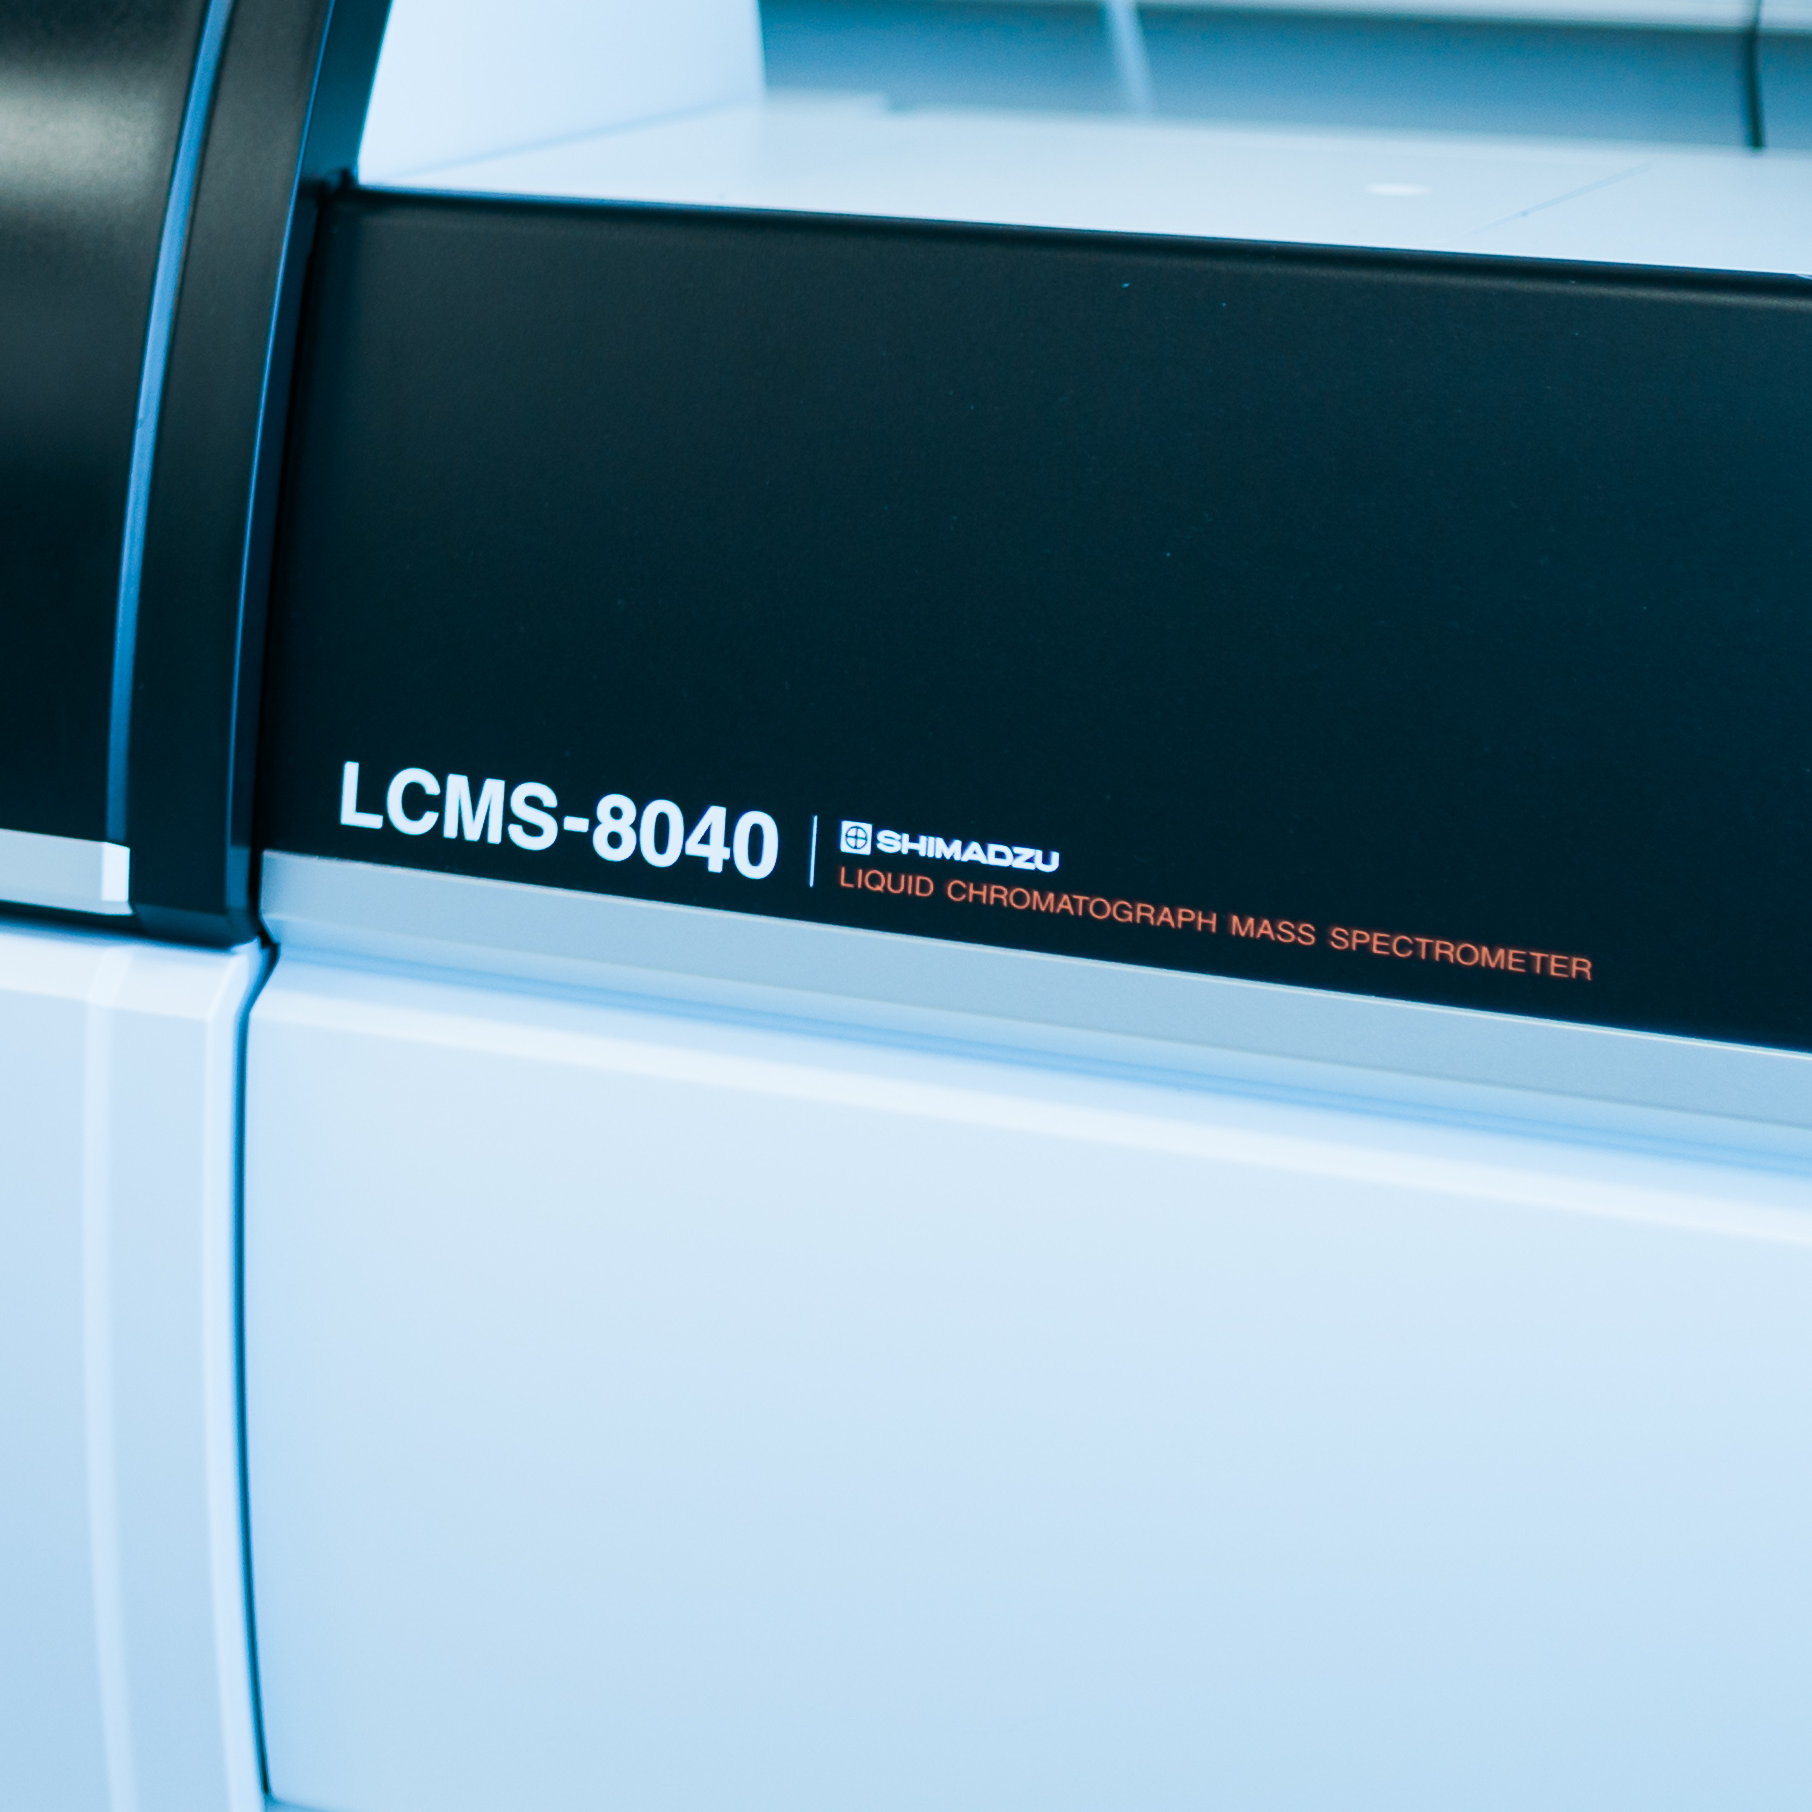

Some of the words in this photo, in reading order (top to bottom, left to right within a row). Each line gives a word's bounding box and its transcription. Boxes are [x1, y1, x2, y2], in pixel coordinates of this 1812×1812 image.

[340, 761, 779, 879] LCMS-8040
[876, 829, 1060, 873] SHIMADZU
[839, 866, 935, 897] LIQUID
[945, 879, 1217, 933] CHROMATOGRAPH
[1229, 914, 1317, 946] MASS
[1328, 926, 1593, 981] SPECTROMETER
